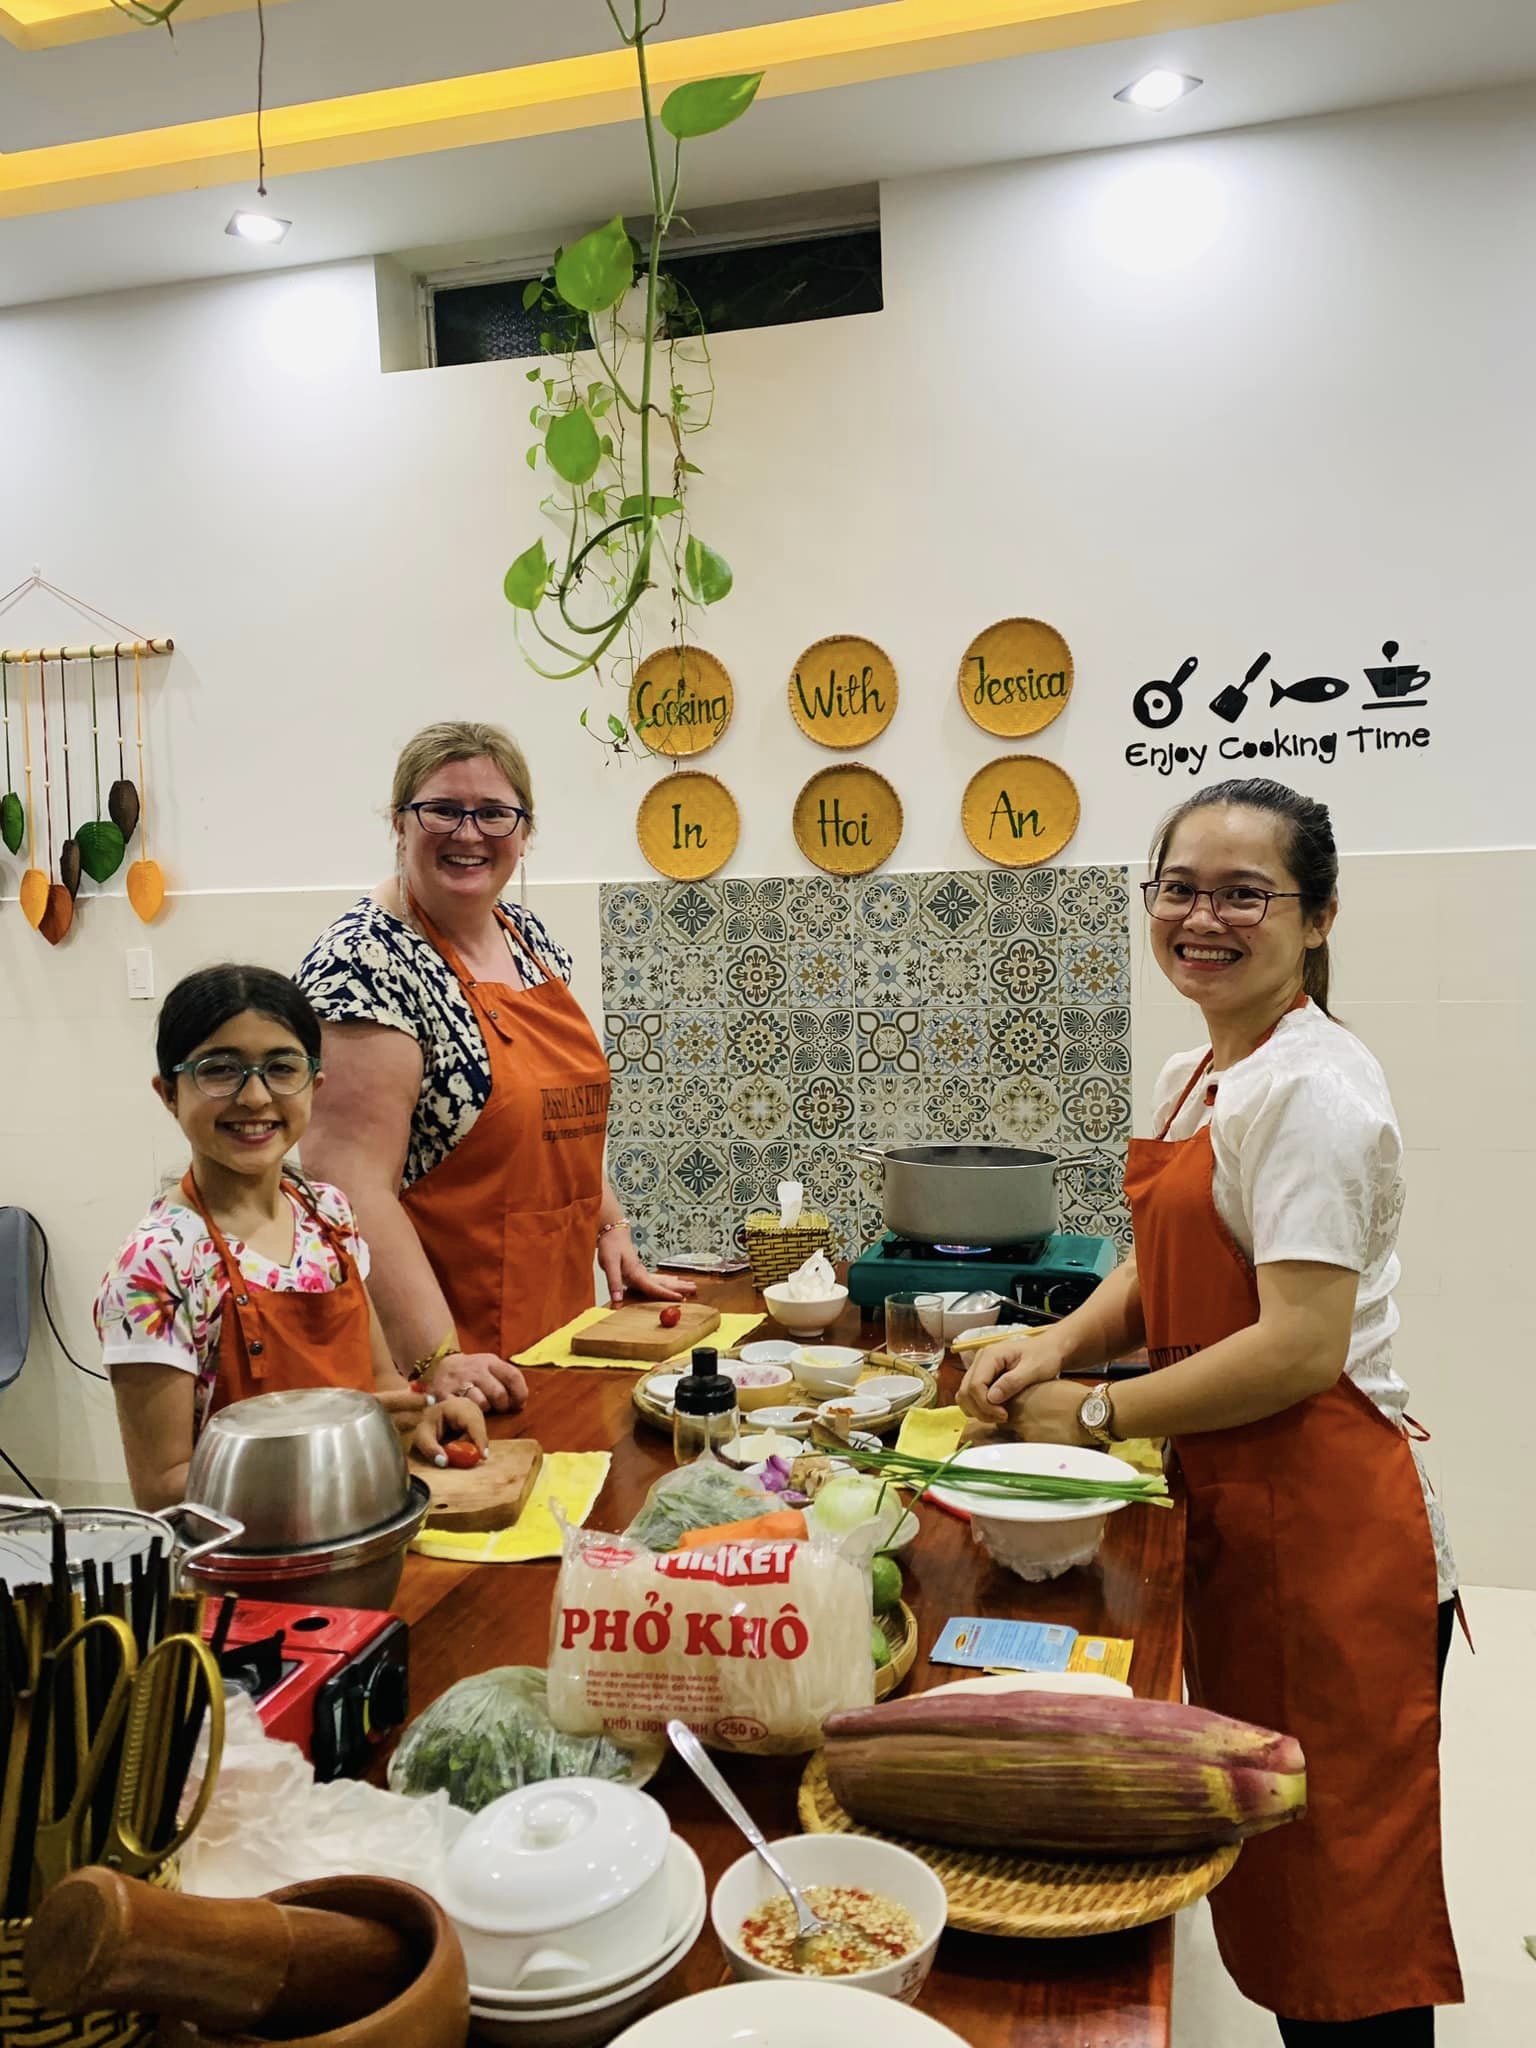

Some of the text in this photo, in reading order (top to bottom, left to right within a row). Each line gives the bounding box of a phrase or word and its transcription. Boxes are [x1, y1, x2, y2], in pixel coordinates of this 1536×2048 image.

[637, 656, 1069, 737] Cooking With Jessica
[1125, 726, 1431, 776] Enjoy Cooking Time
[672, 790, 1046, 850] In Hoi An
[561, 1590, 809, 1660] PHỞ KHÔ
[721, 1722, 747, 1736] 250
